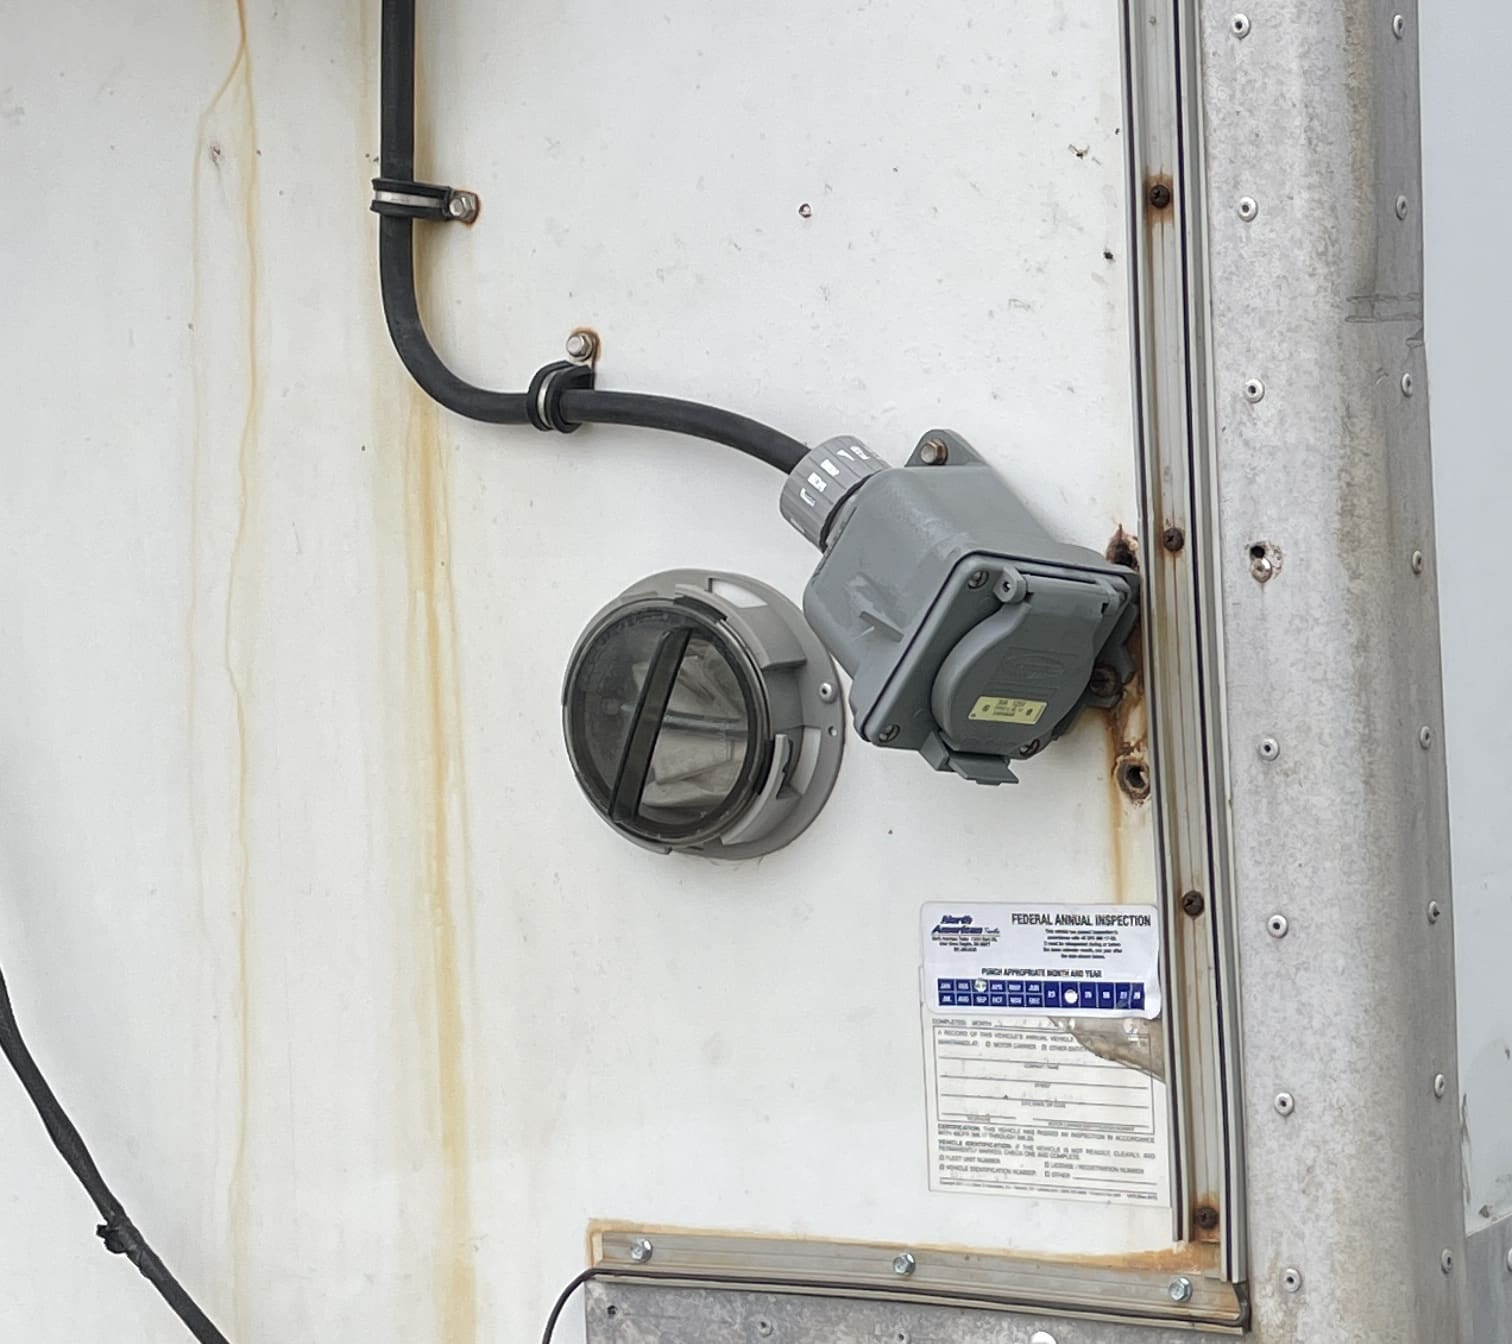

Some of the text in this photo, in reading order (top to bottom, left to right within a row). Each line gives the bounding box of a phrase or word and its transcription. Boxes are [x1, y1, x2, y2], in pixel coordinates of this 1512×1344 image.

[1011, 913, 1152, 927] FEDERAL ANNUAL INSPECTION
[1046, 969, 1070, 977] MONTH
[1070, 969, 1084, 977] AND
[1085, 969, 1103, 978] YEAR
